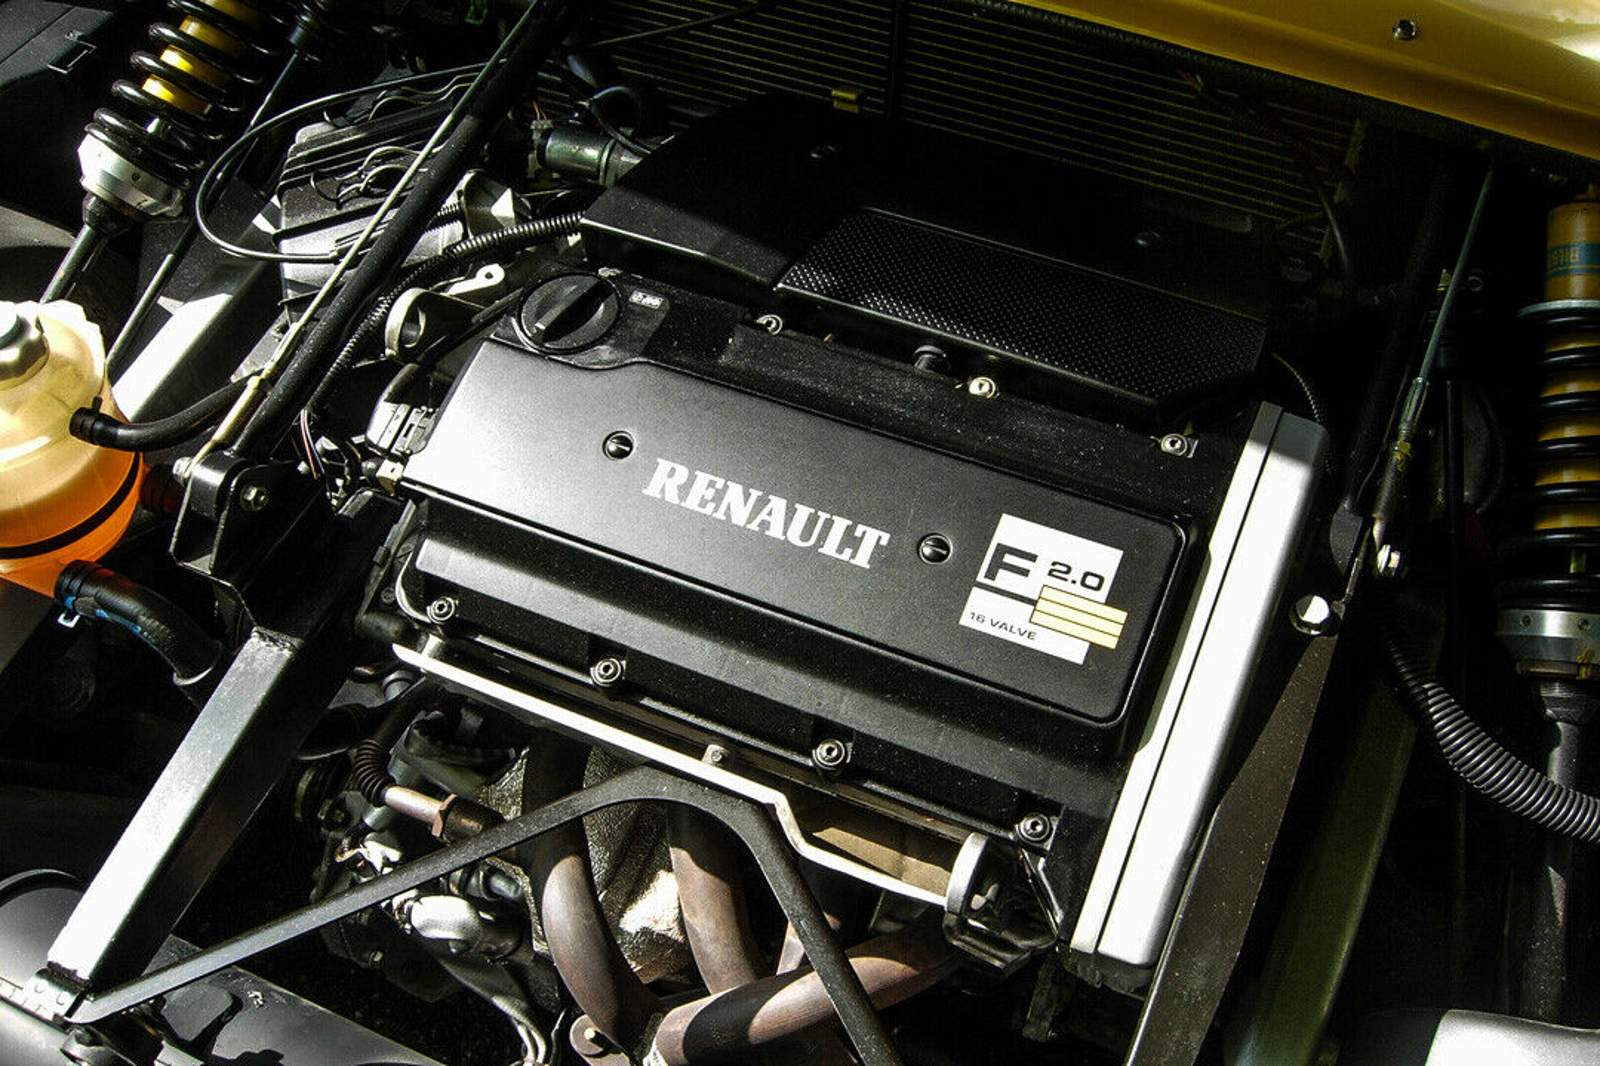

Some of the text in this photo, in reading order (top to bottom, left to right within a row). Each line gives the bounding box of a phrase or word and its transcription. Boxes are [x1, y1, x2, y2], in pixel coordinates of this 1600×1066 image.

[642, 458, 891, 569] RENAULT
[984, 542, 1105, 591] F 2.0
[969, 611, 1037, 641] 16 VALVE
